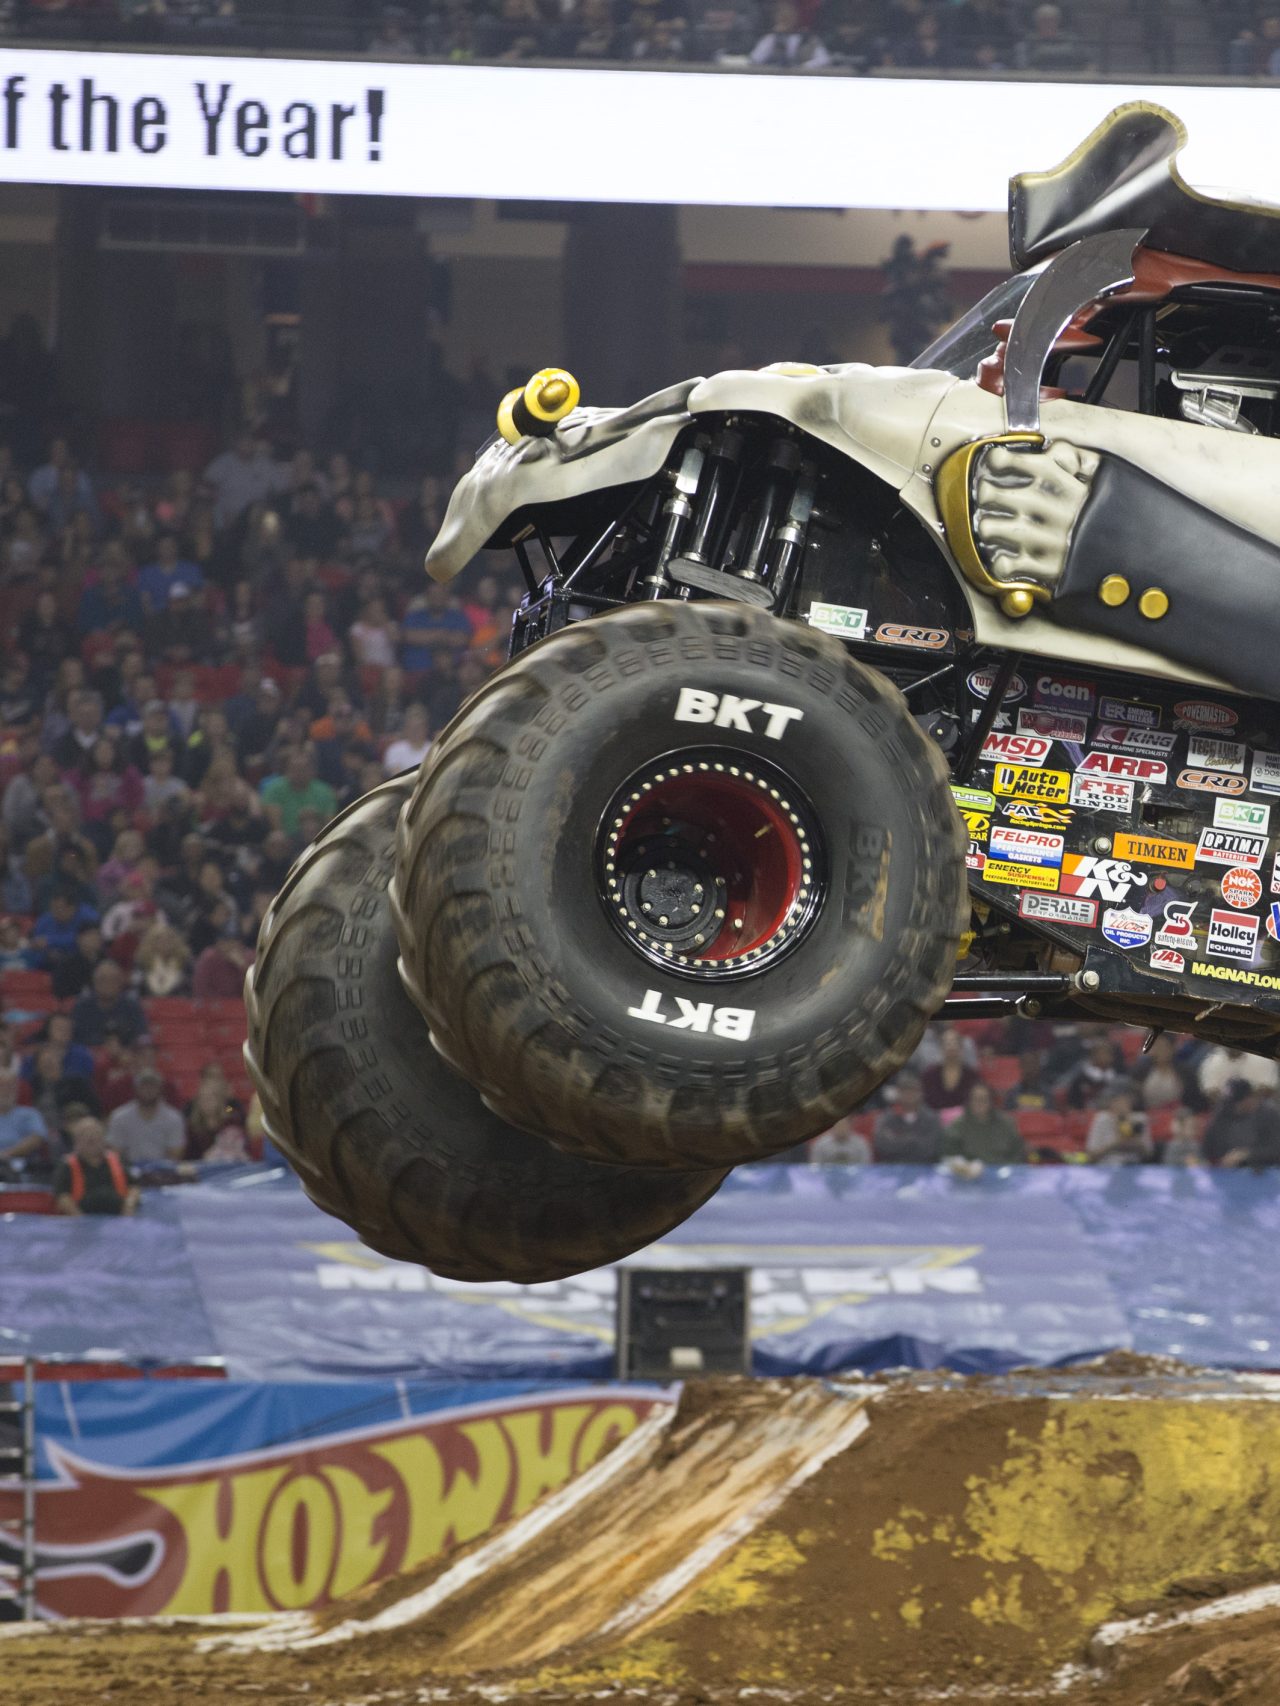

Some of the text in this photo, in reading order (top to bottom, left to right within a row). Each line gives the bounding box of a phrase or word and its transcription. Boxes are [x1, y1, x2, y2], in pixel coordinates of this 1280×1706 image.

[4, 75, 385, 162] f the Year!
[813, 607, 863, 628] BKT
[881, 626, 945, 643] CRD
[1036, 676, 1090, 701] Coan
[674, 687, 804, 740] BKT
[1104, 704, 1127, 720] ER
[1127, 706, 1154, 718] ENERGY
[1182, 703, 1230, 723] POWERMASTER
[982, 734, 1048, 756] MSD
[1127, 732, 1173, 747] KING
[1090, 741, 1169, 758] ENGINE BEARING SPECIALISTS
[1080, 753, 1167, 778] ARP
[1017, 769, 1059, 785] Auto
[1182, 772, 1244, 789] CRD
[1013, 781, 1066, 798] Meter
[1079, 780, 1130, 796] FK
[1074, 798, 1128, 811] ENDS
[1087, 792, 1129, 804] ROD
[1003, 803, 1043, 818] PAC
[1218, 802, 1266, 824] BKT
[992, 829, 1061, 848] FEL-PRO
[1204, 832, 1261, 855] OPTIMA
[996, 843, 1056, 858] PERFORMANCE
[1007, 852, 1042, 864] GASKETS
[1127, 840, 1188, 862] TIMKEN
[1212, 850, 1248, 862] BATTERIES
[988, 862, 1031, 874] ENERGY
[1007, 871, 1056, 883] SUSPENSION
[1228, 875, 1256, 889] NGK
[1228, 893, 1254, 903] PLUGS
[1229, 888, 1253, 897] SPARK
[1028, 895, 1090, 917] DERALE
[1026, 909, 1089, 923] PERFORMANCE
[1109, 918, 1148, 933] LUCAS
[1105, 928, 1148, 941] OIL PRODUCTS
[1210, 922, 1256, 946] Holley
[1209, 942, 1253, 957] EQUIPPED
[627, 989, 756, 1041] BKT
[136, 1463, 395, 1615] HOT
